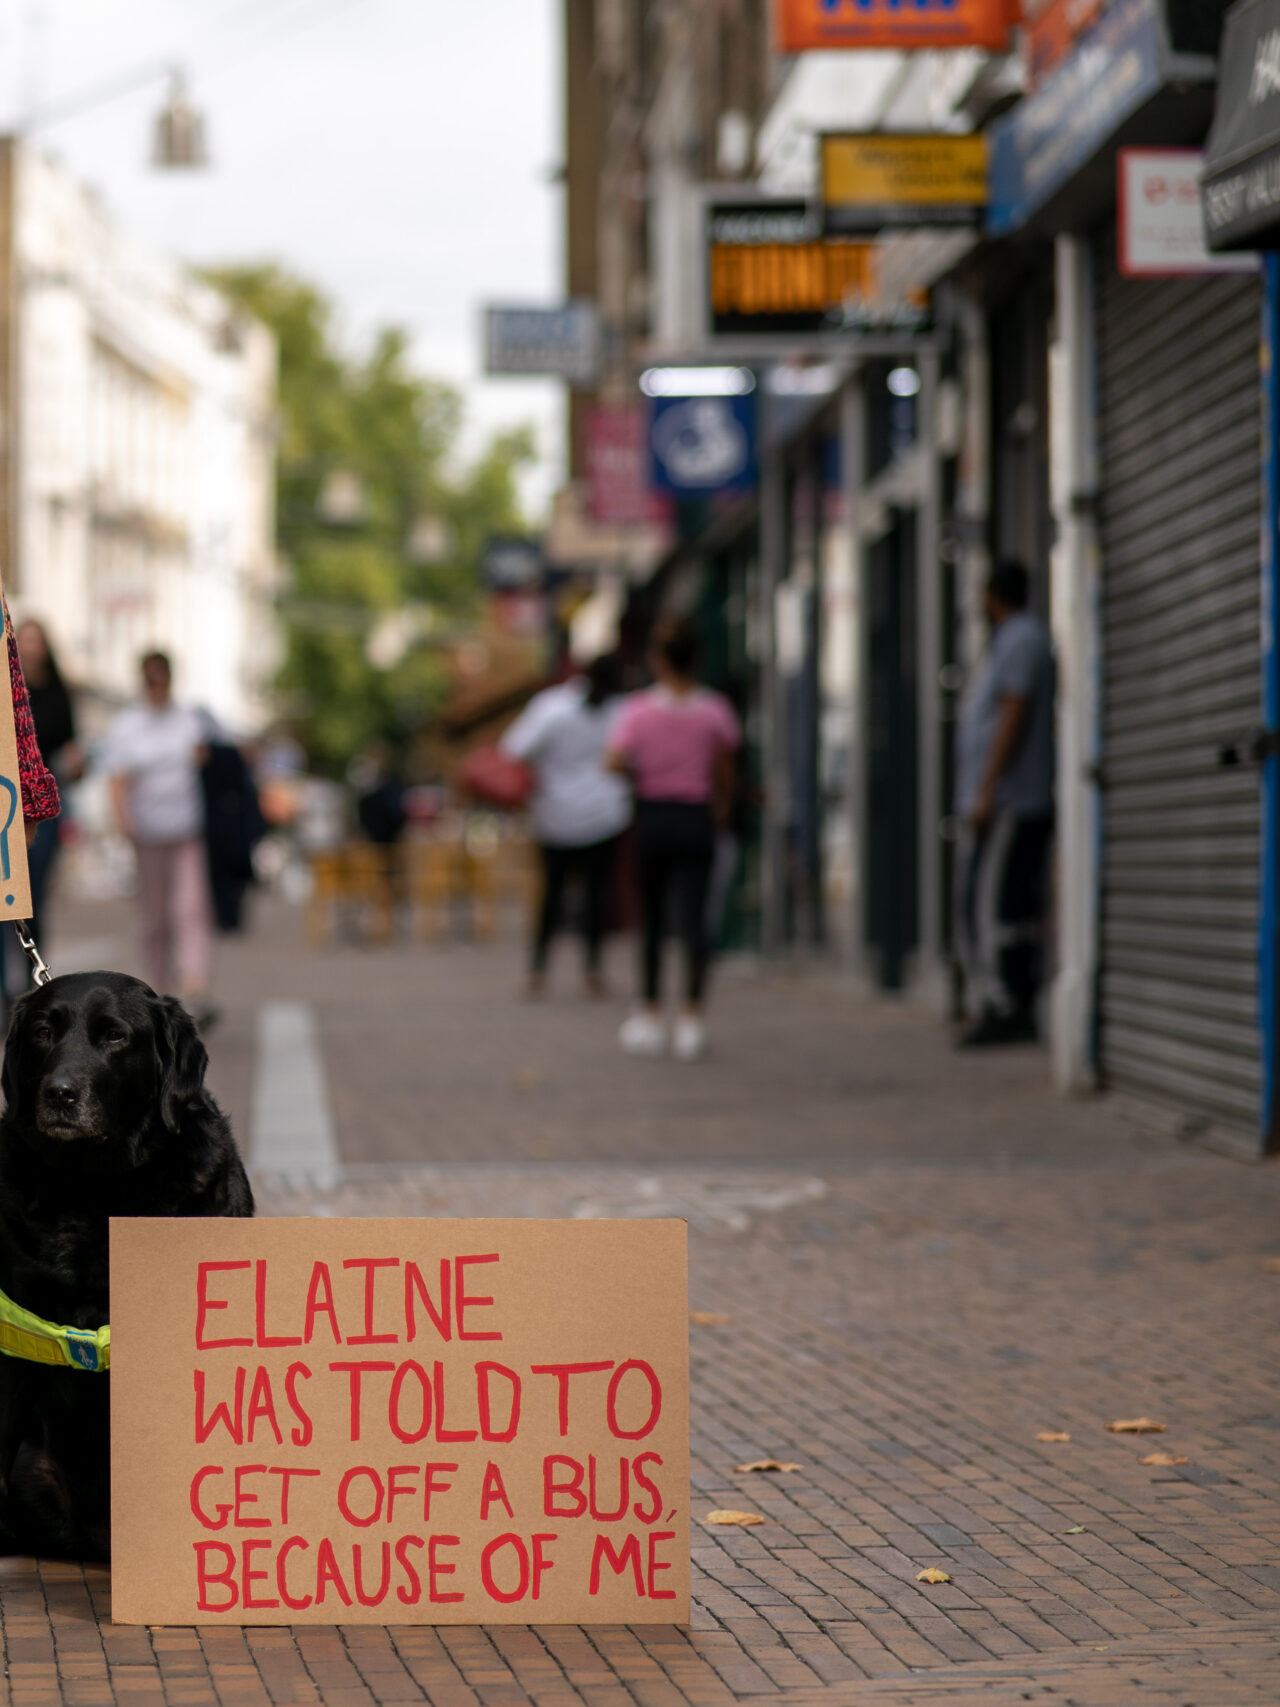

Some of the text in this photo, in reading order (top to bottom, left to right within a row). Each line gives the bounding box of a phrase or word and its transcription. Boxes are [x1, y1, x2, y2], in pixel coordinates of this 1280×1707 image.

[195, 1253, 504, 1351] ELAINE
[194, 1359, 663, 1446] WAS TOLD TO
[189, 1451, 678, 1531] GET OFF A BUS,
[193, 1530, 677, 1613] BECAUSE OF ME
